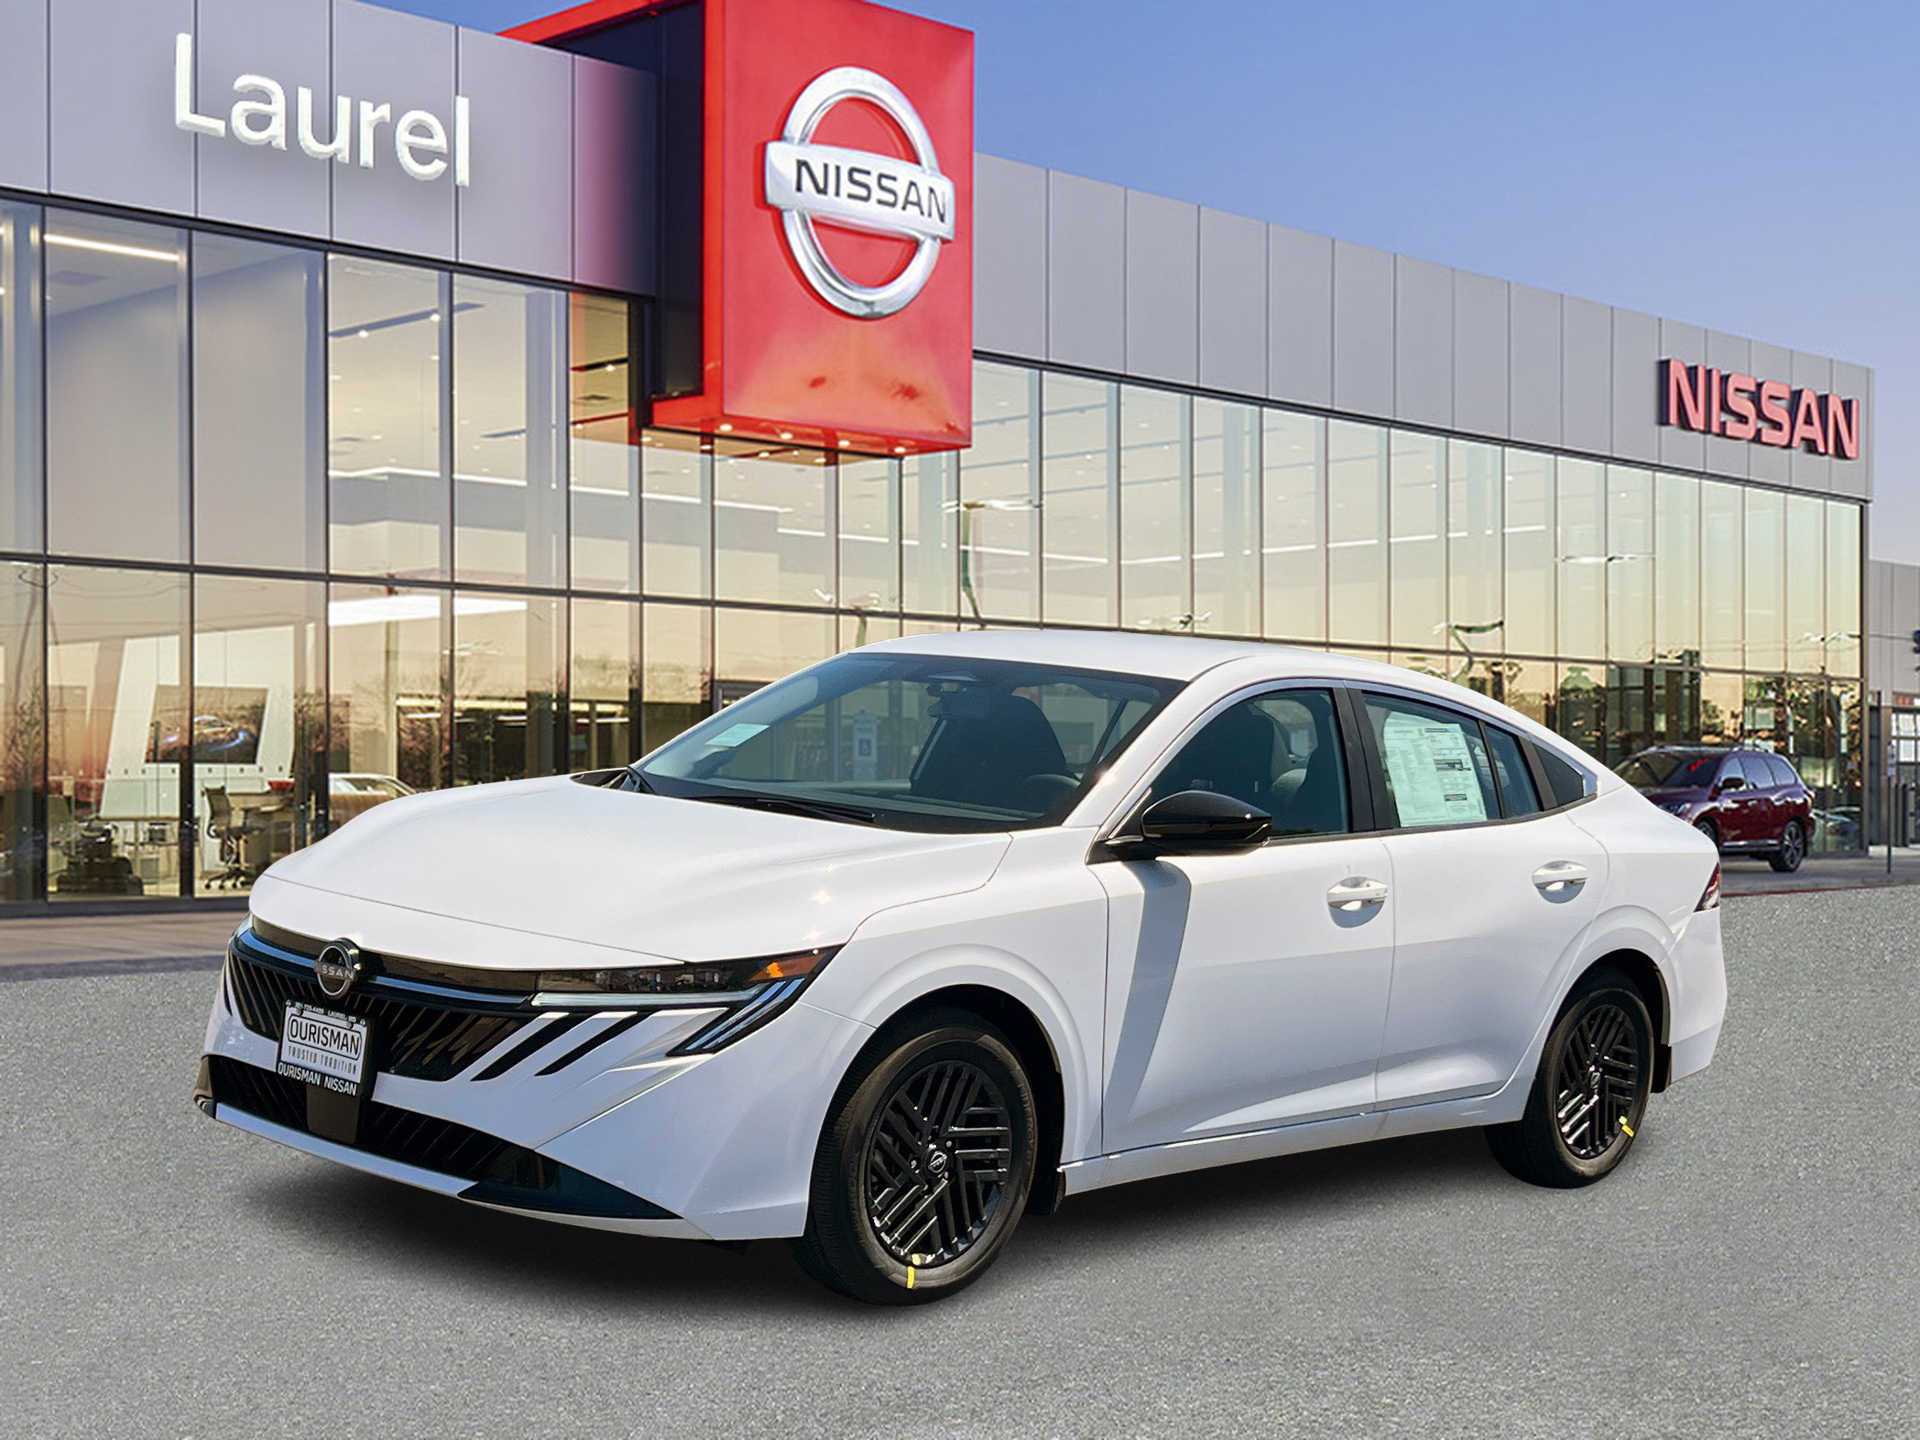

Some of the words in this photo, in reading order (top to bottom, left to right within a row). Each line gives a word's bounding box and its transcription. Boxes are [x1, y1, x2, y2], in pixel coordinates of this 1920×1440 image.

[174, 32, 470, 188] Laurel
[795, 158, 947, 224] NISSAN
[1659, 358, 1860, 460] NISSAN
[317, 963, 354, 979] SSAN
[289, 1018, 360, 1056] OURISMAN
[277, 1062, 321, 1086] OURISMAN
[323, 1075, 357, 1096] NISSAN
[288, 1046, 318, 1064] TRUSTED
[320, 1054, 357, 1075] TRADITION
